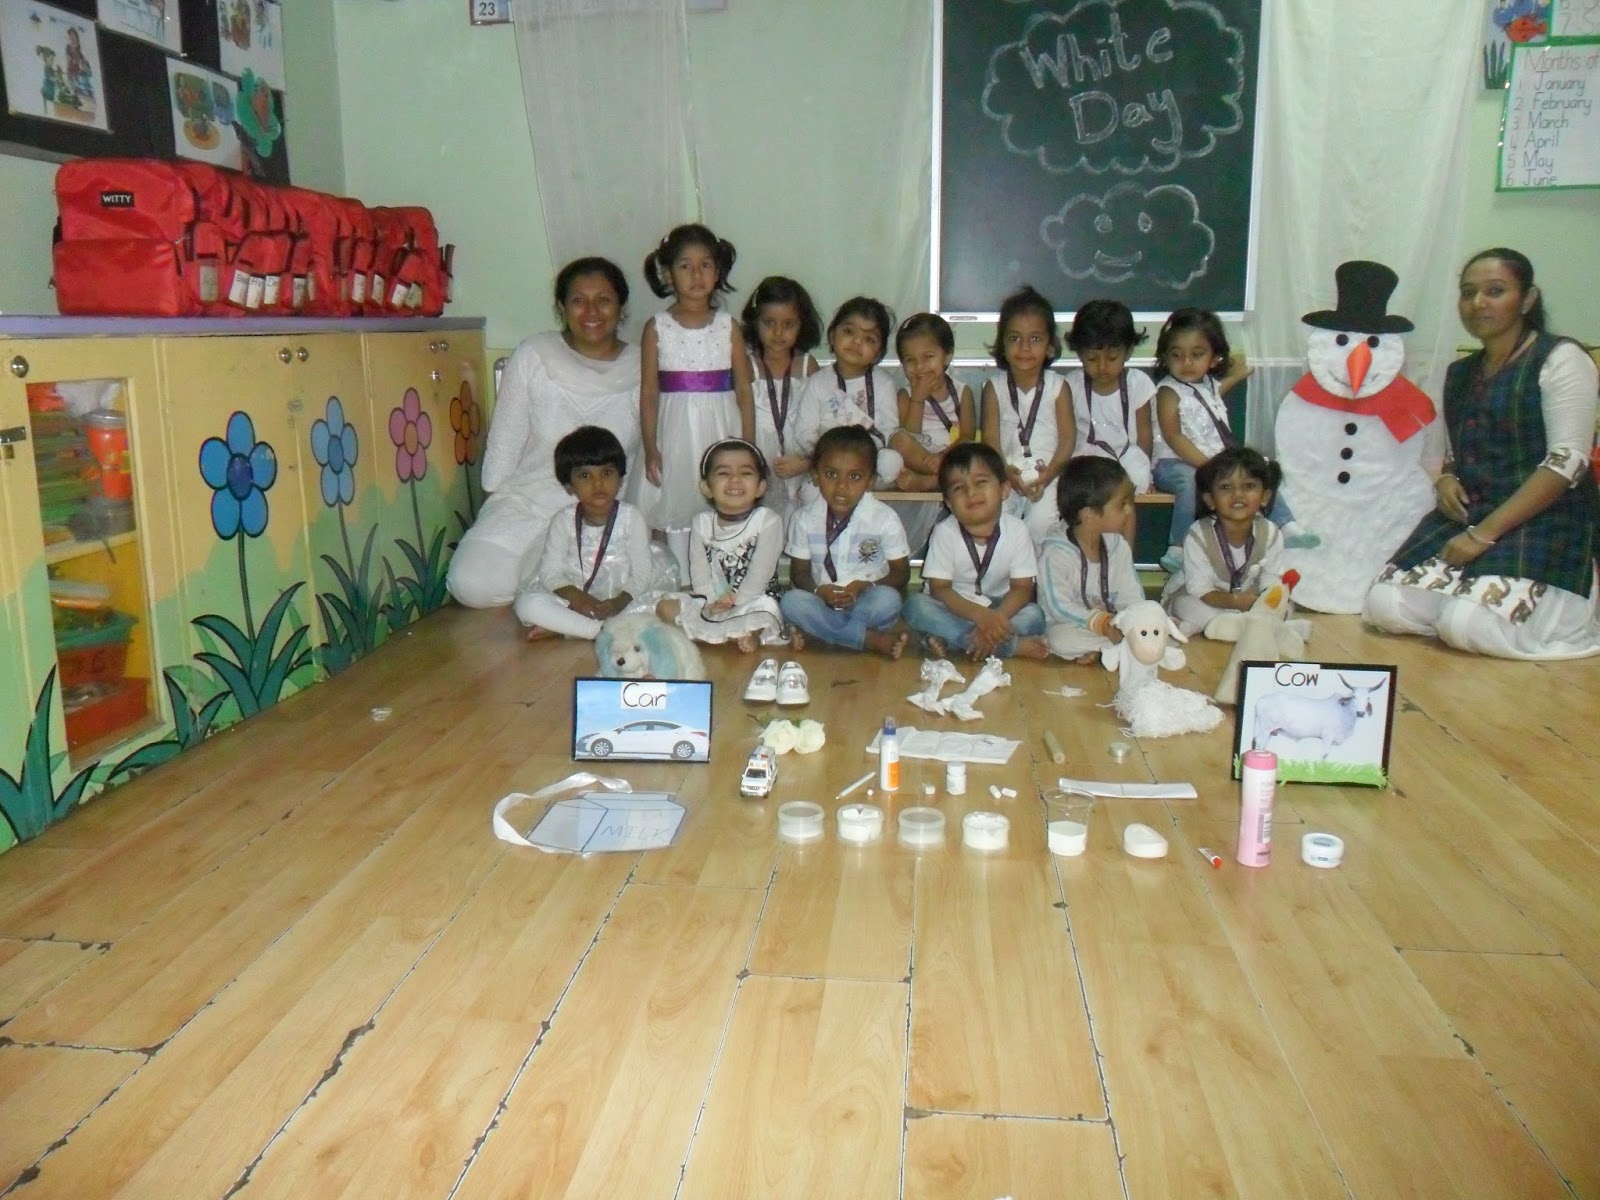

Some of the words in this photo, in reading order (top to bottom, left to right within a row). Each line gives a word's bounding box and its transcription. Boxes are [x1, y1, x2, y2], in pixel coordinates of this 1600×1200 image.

[478, 2, 496, 16] 23
[1019, 12, 1174, 89] White
[1525, 49, 1580, 71] Months
[1534, 70, 1586, 97] January
[1532, 91, 1592, 115] February
[1068, 88, 1183, 153] Day
[1528, 111, 1569, 129] March
[1524, 130, 1560, 151] April
[1523, 150, 1554, 174] May
[1523, 168, 1558, 187] June
[102, 194, 132, 203] WITTY
[1275, 664, 1319, 687] Cow
[622, 682, 667, 708] Car
[600, 824, 671, 842] MILK
